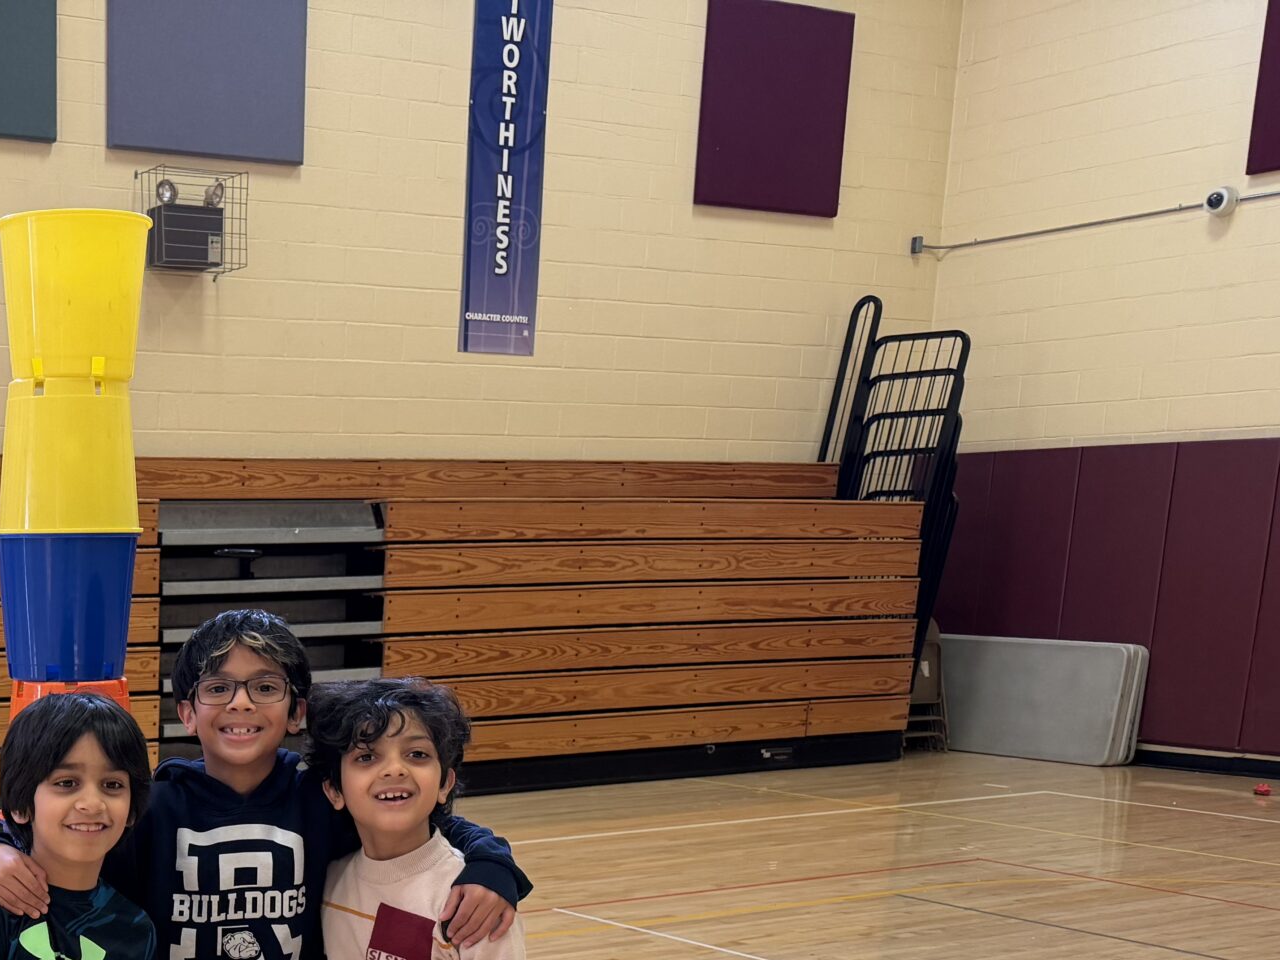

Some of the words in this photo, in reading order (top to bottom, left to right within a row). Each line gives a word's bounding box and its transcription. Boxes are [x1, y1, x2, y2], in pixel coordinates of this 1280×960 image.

[464, 311, 502, 323] CHARACTER
[500, 313, 530, 325] COUNTS!
[170, 885, 306, 924] BULLDOGS
